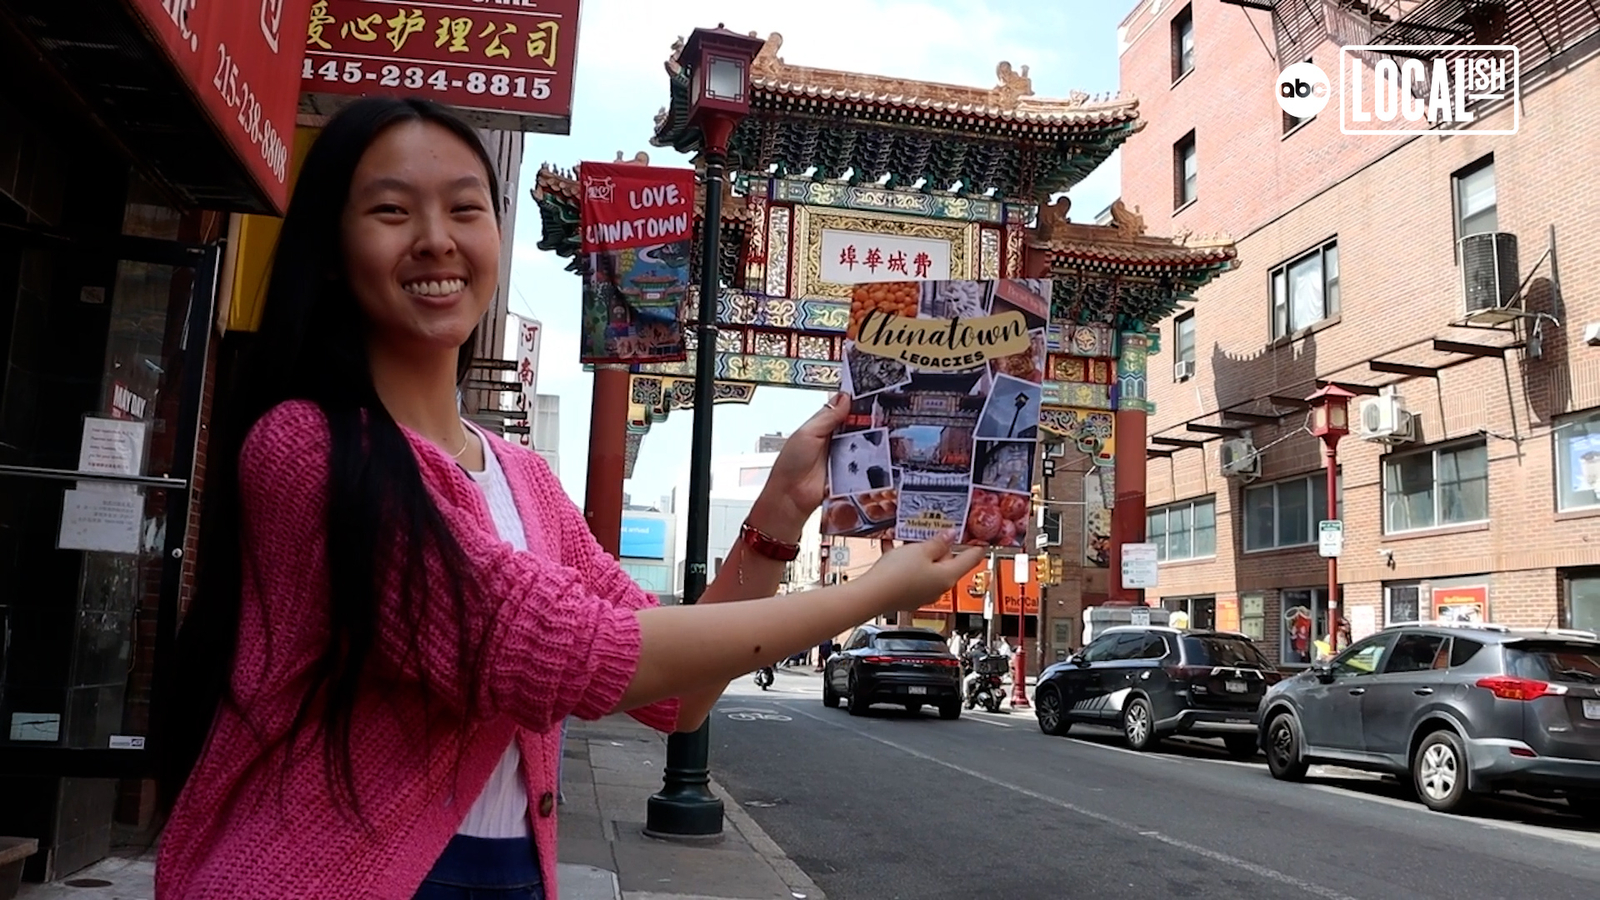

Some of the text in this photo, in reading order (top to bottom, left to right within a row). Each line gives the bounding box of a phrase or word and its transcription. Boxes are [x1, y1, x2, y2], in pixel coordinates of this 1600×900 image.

[213, 43, 287, 183] 215-238-8808
[586, 212, 687, 245] CHINATOWN
[857, 305, 1028, 351] Chinatown
[900, 349, 985, 367] LEGACIES
